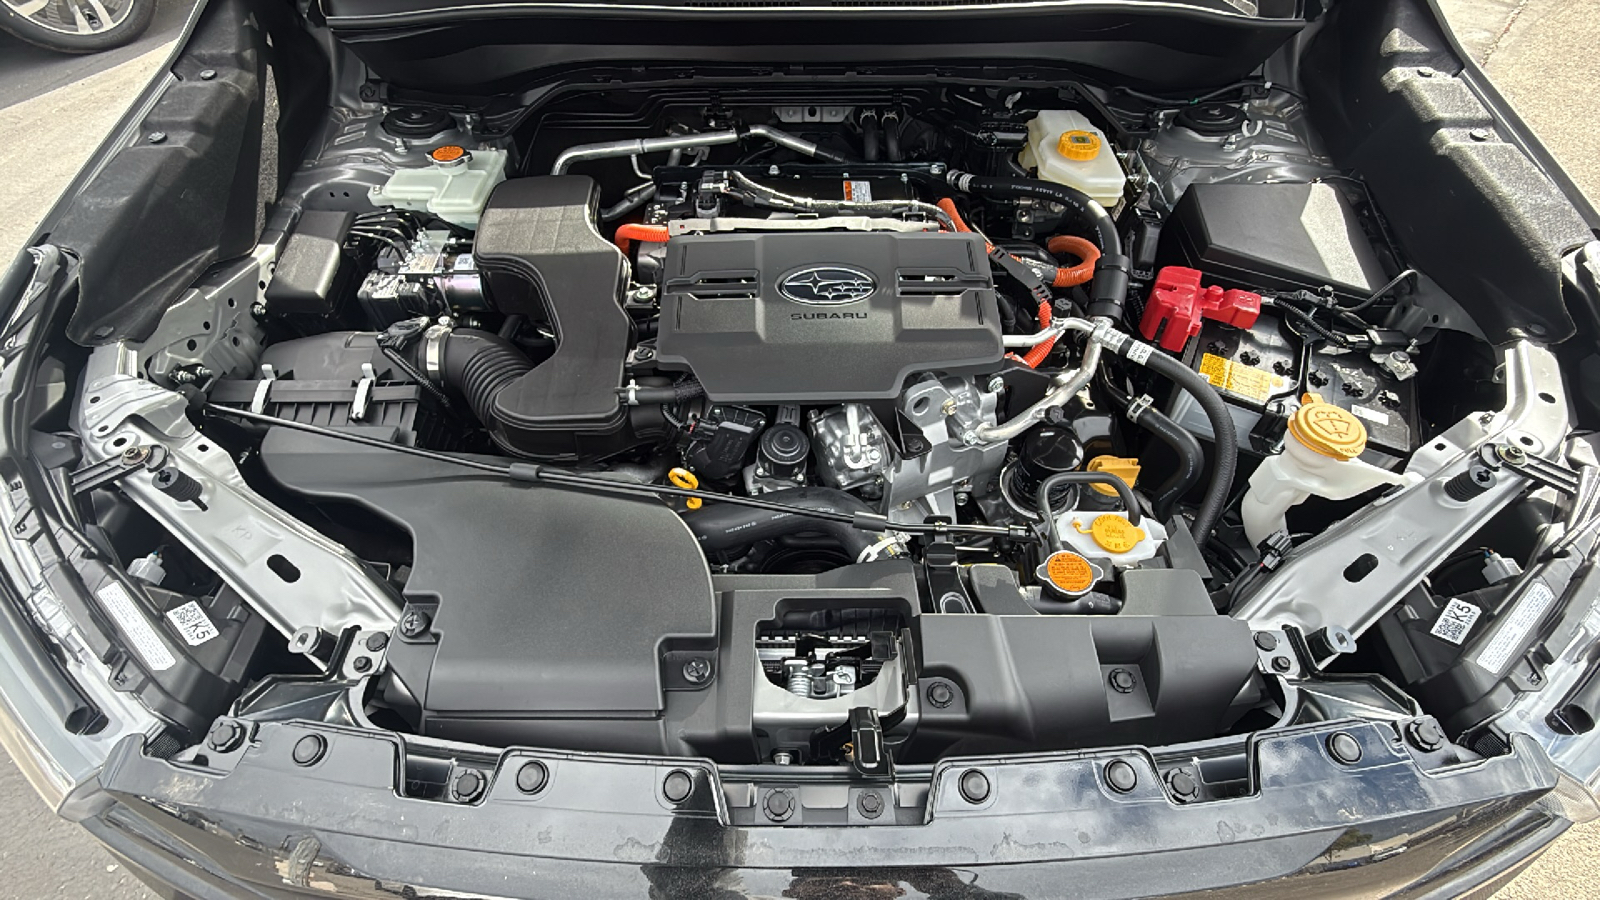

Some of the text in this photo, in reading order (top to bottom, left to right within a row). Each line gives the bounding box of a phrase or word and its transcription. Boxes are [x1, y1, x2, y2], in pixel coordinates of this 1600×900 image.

[790, 312, 868, 321] SUBARU
[1450, 604, 1471, 622] K5
[188, 621, 211, 639] K5
